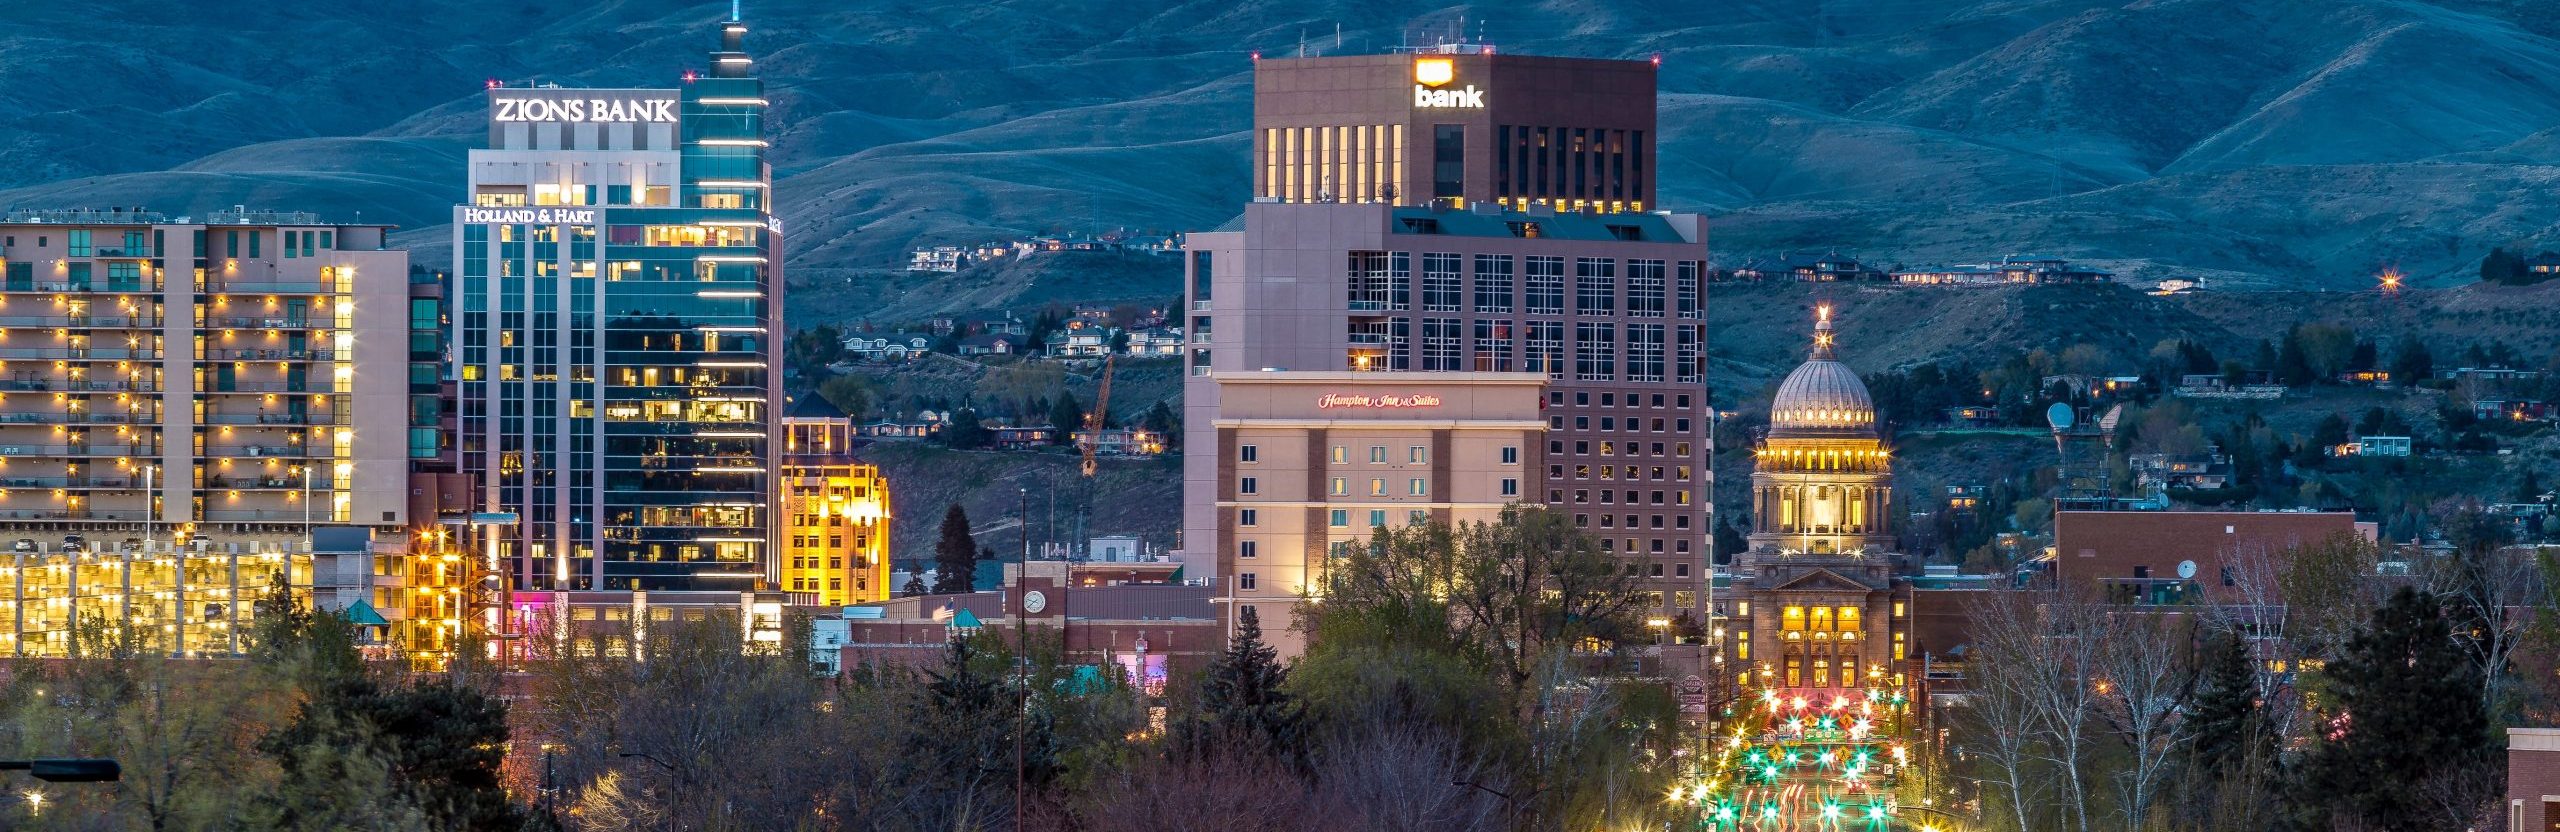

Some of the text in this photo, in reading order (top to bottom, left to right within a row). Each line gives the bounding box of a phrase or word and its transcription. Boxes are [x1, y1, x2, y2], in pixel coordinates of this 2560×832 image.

[1414, 84, 1485, 108] bank
[495, 98, 678, 122] ZIONS BANK
[464, 208, 595, 223] HOLLAND & HART
[1318, 393, 1375, 409] Hampton
[1375, 394, 1403, 408] Inn
[1408, 394, 1440, 408] Suites
